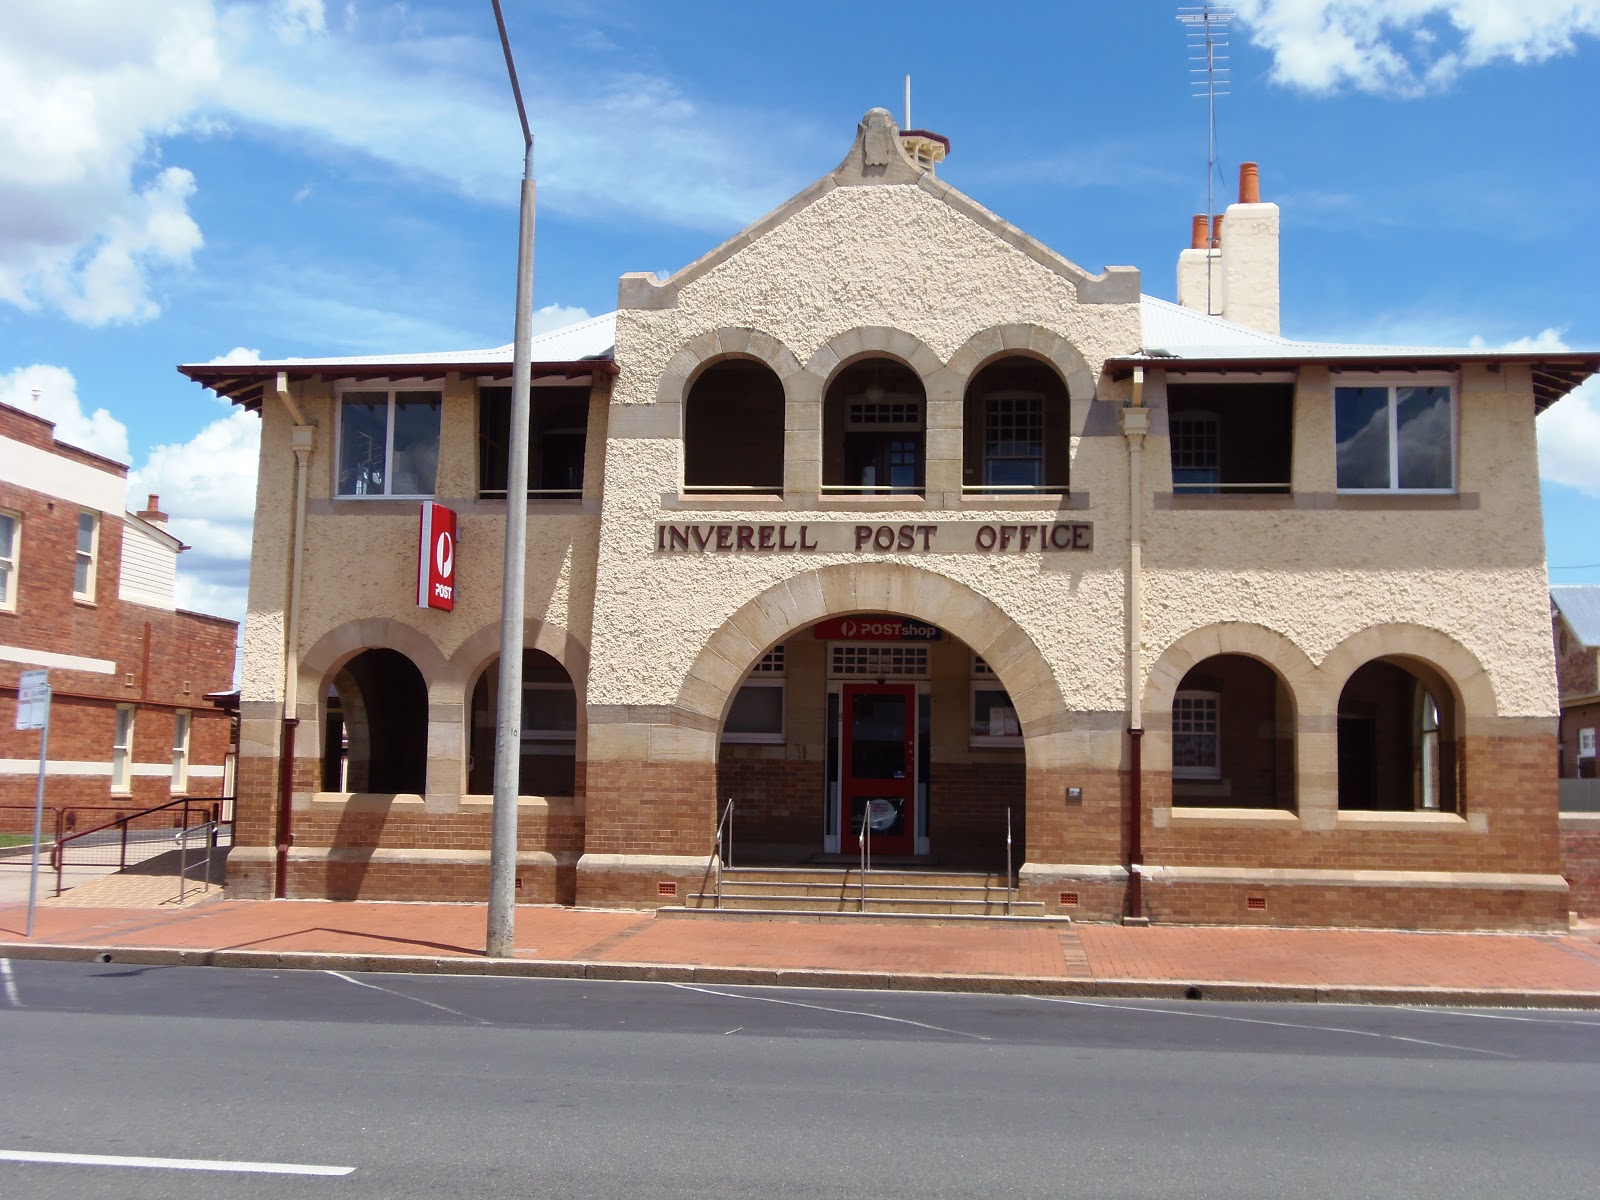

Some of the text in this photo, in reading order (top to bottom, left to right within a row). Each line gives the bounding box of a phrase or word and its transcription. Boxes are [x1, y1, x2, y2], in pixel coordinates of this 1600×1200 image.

[658, 524, 1090, 550] INVERELL POST OFFICE
[435, 583, 452, 599] POST
